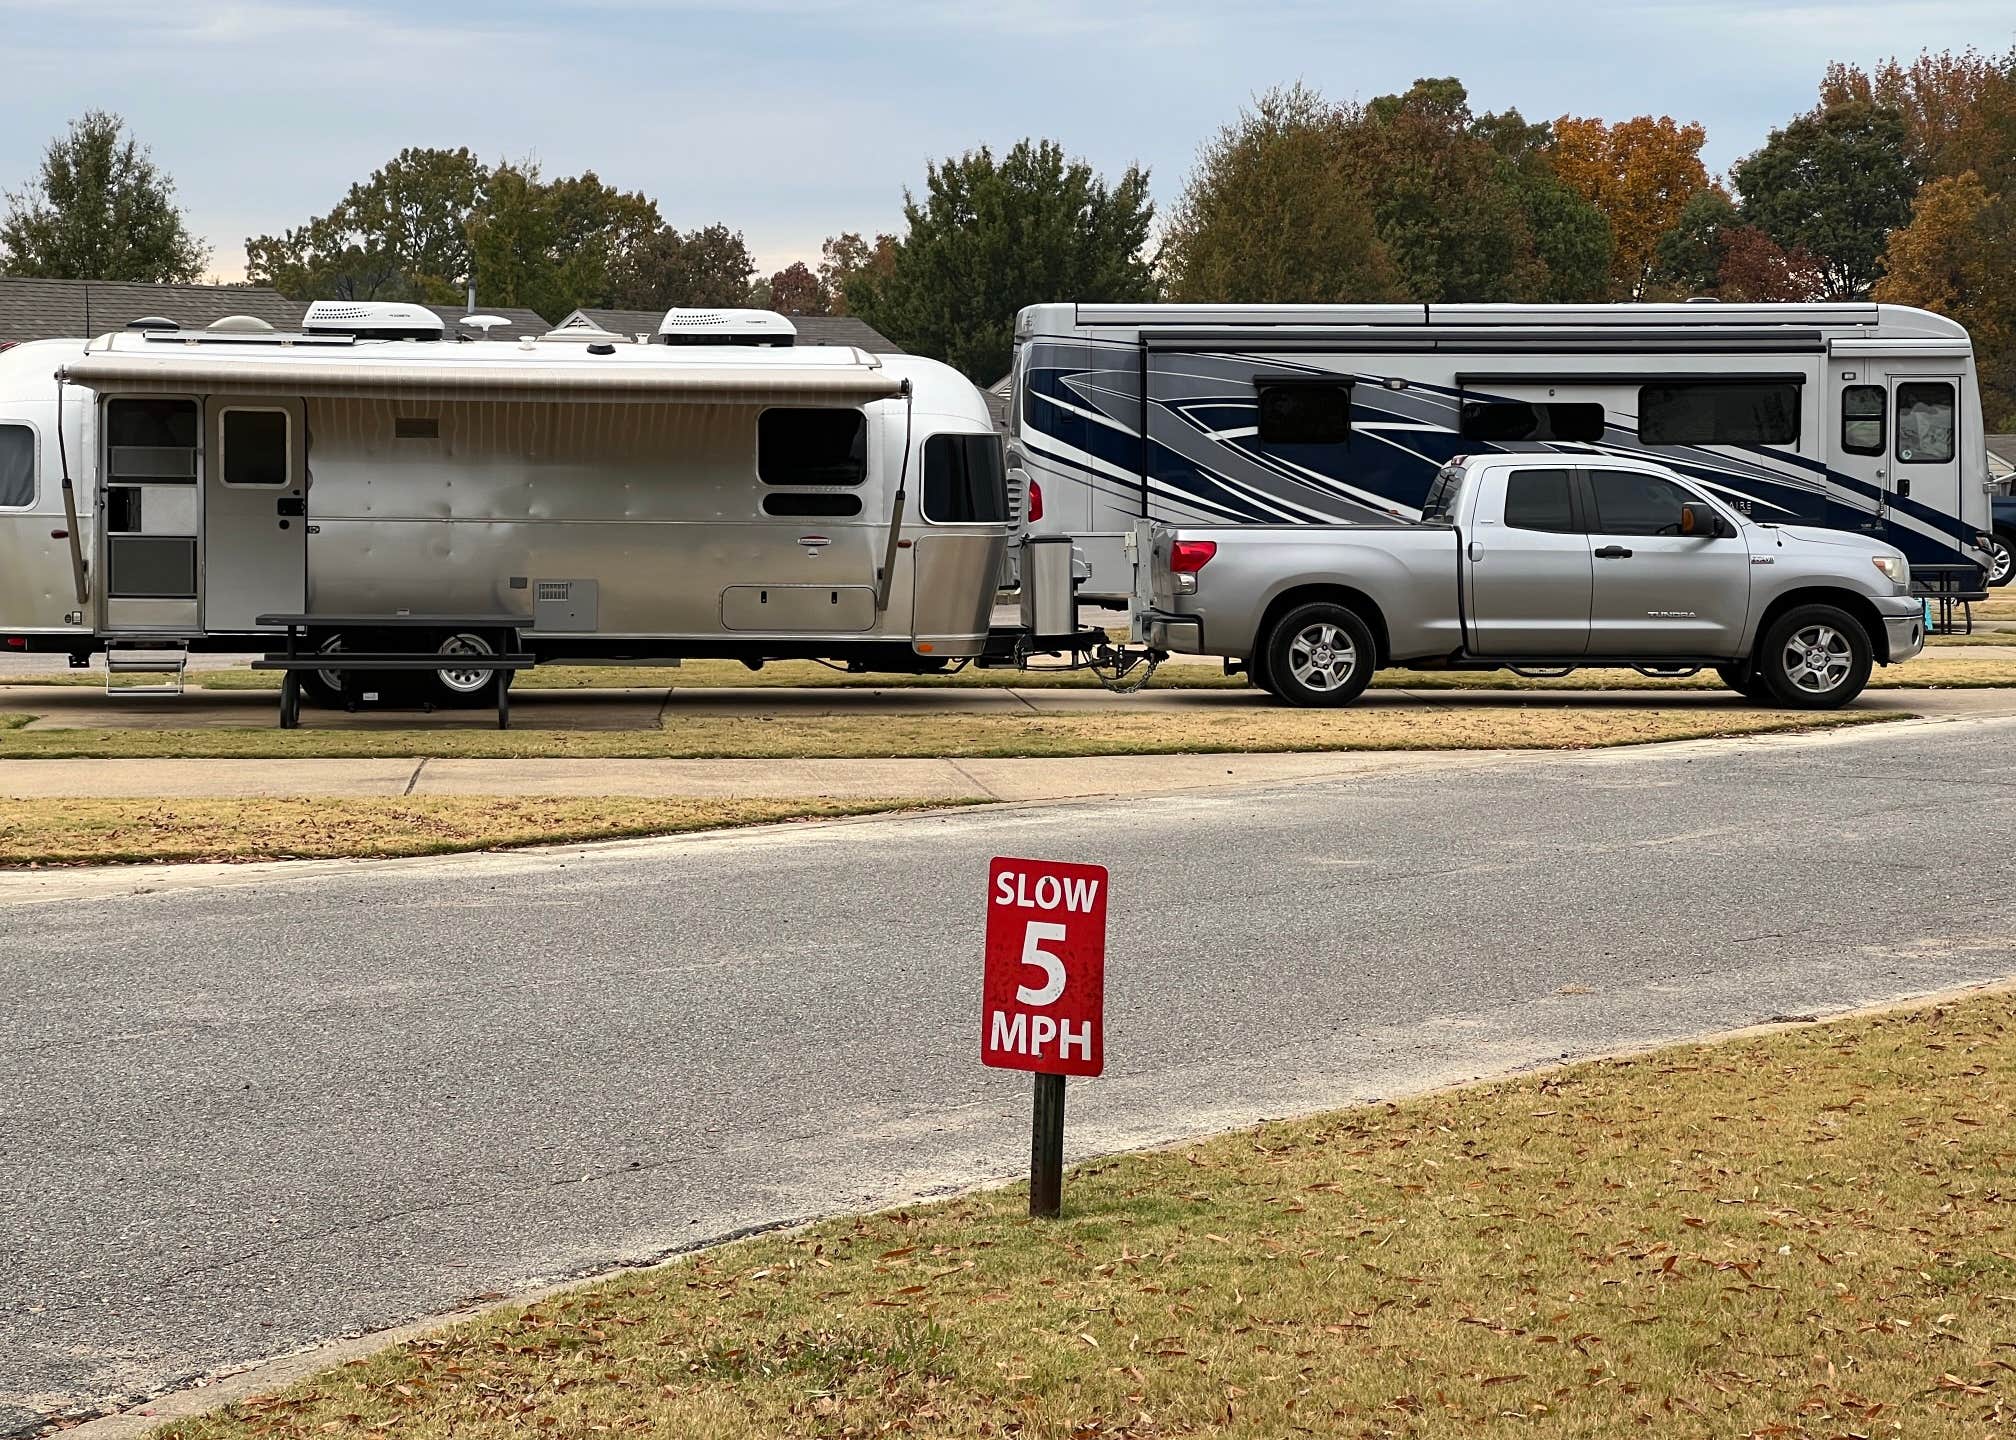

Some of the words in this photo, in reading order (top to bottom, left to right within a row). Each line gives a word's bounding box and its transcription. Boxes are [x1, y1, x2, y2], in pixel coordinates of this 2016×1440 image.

[995, 871, 1099, 913] SLOW
[1016, 921, 1067, 1006] 5
[990, 1010, 1092, 1061] MPH
